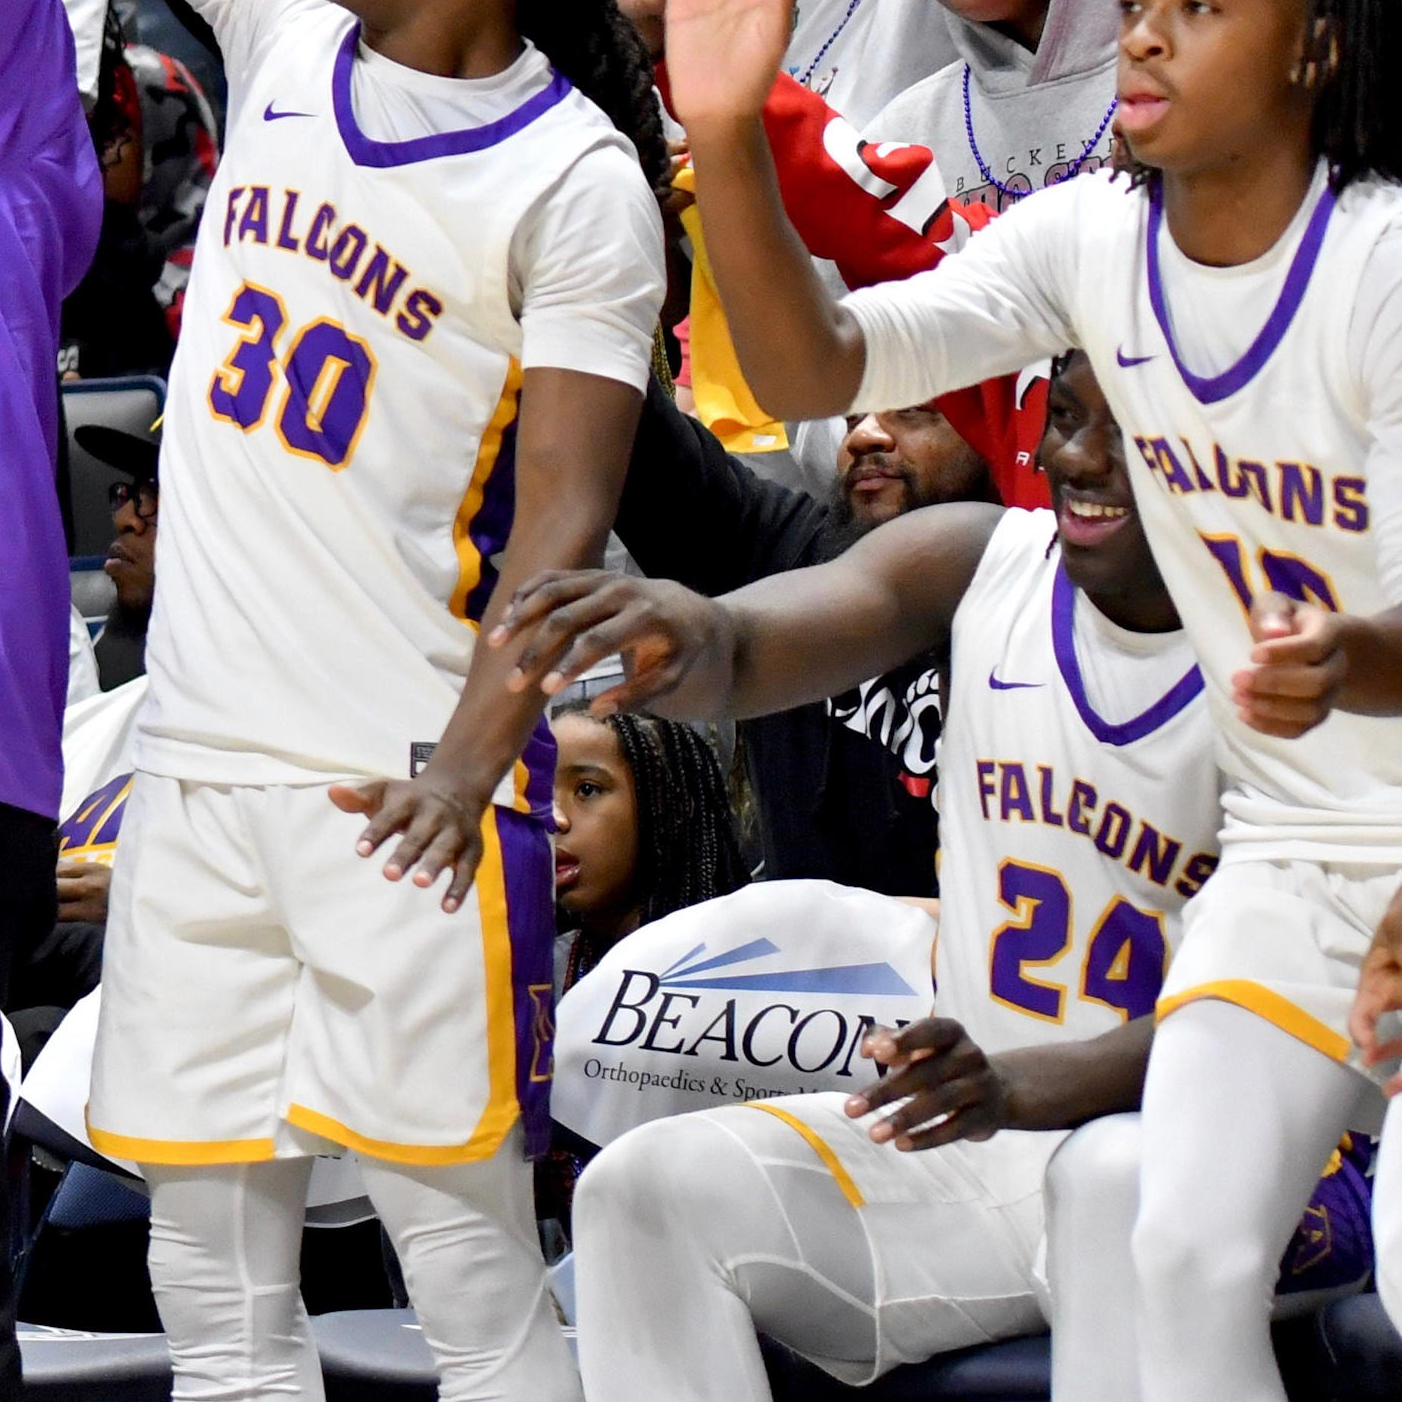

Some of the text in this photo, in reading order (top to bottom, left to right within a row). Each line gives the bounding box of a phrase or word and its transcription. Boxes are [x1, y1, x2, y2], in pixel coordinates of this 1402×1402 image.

[222, 184, 444, 343] FALCONS
[206, 278, 379, 473] 30
[976, 759, 1219, 899] FALCONS
[989, 856, 1173, 1026] 24
[584, 1059, 706, 1093] Orthopaedics
[709, 1077, 728, 1096] &
